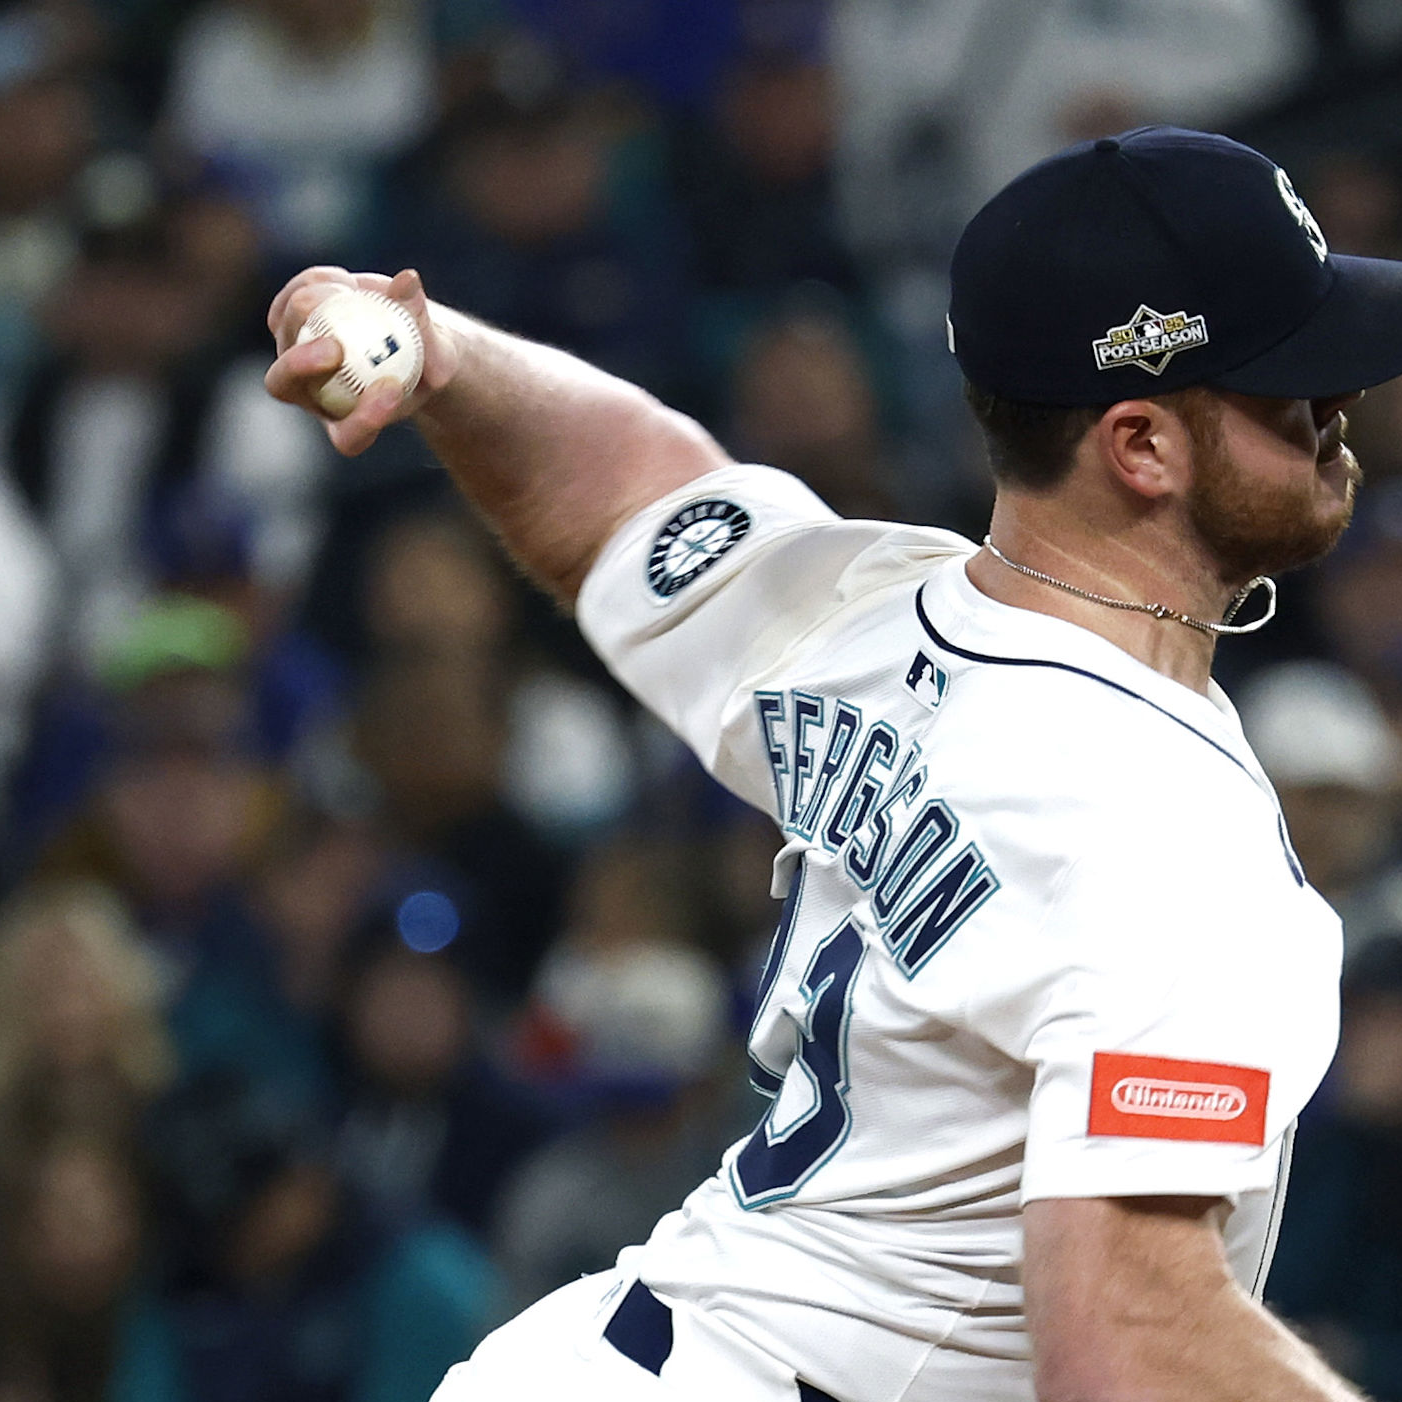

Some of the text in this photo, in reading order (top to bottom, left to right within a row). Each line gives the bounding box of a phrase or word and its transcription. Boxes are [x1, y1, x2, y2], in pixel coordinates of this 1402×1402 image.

[1098, 324, 1203, 364] POSTSEASON
[754, 689, 1001, 982] FERGSON
[1122, 1082, 1239, 1114] Nintendo
